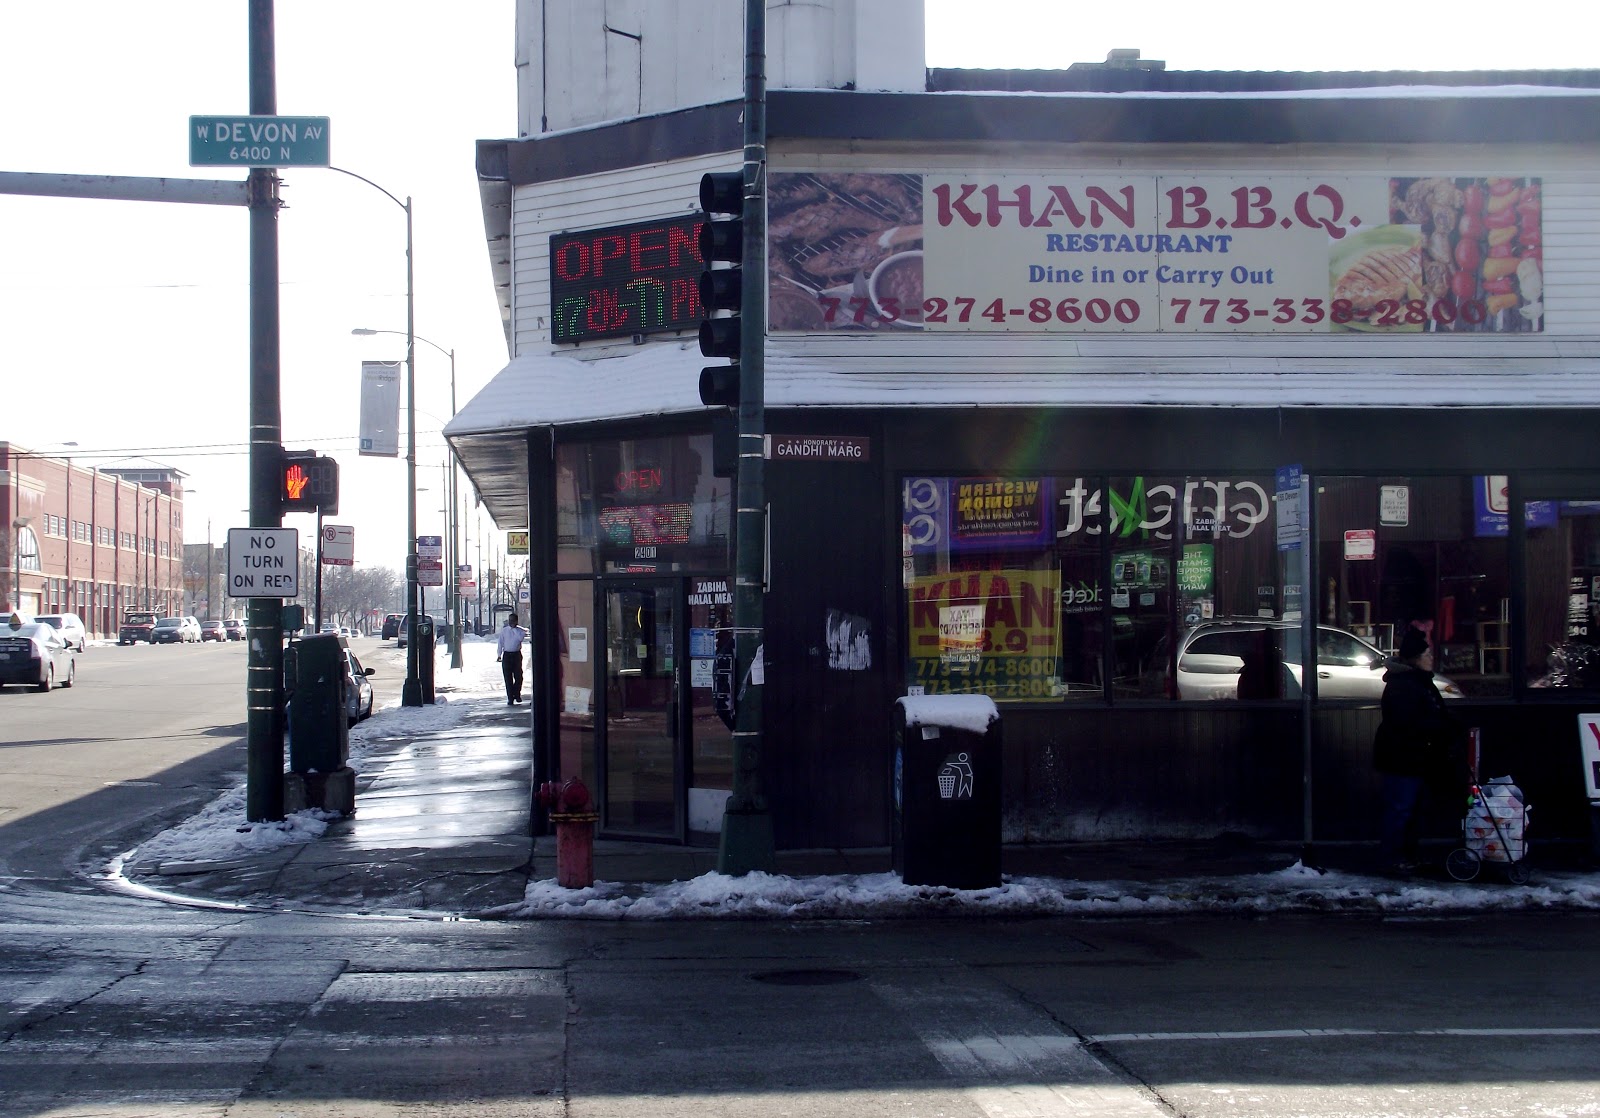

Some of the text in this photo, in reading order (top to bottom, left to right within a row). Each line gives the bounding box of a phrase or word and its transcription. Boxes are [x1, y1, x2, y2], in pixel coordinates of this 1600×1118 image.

[197, 123, 322, 142] W DEVON AV
[229, 147, 290, 160] 6400 N
[932, 183, 1362, 239] KHAN B.B.Q.
[1046, 234, 1232, 253] RESTAURANT
[556, 223, 704, 281] OPEN
[1029, 265, 1274, 288] Dine in or Carry Out
[818, 296, 1487, 324] 773-274-8600 773-338-2800
[777, 444, 862, 457] GANDHI MARG
[1289, 467, 1299, 476] bus
[615, 468, 662, 490] OPEN
[251, 536, 275, 549] NO
[634, 546, 657, 559] 2401
[243, 556, 284, 568] TURN
[234, 575, 292, 588] ON RED
[697, 581, 727, 593] ZABIHA
[688, 593, 734, 606] HALAL MEA
[913, 575, 1055, 628] KHAN
